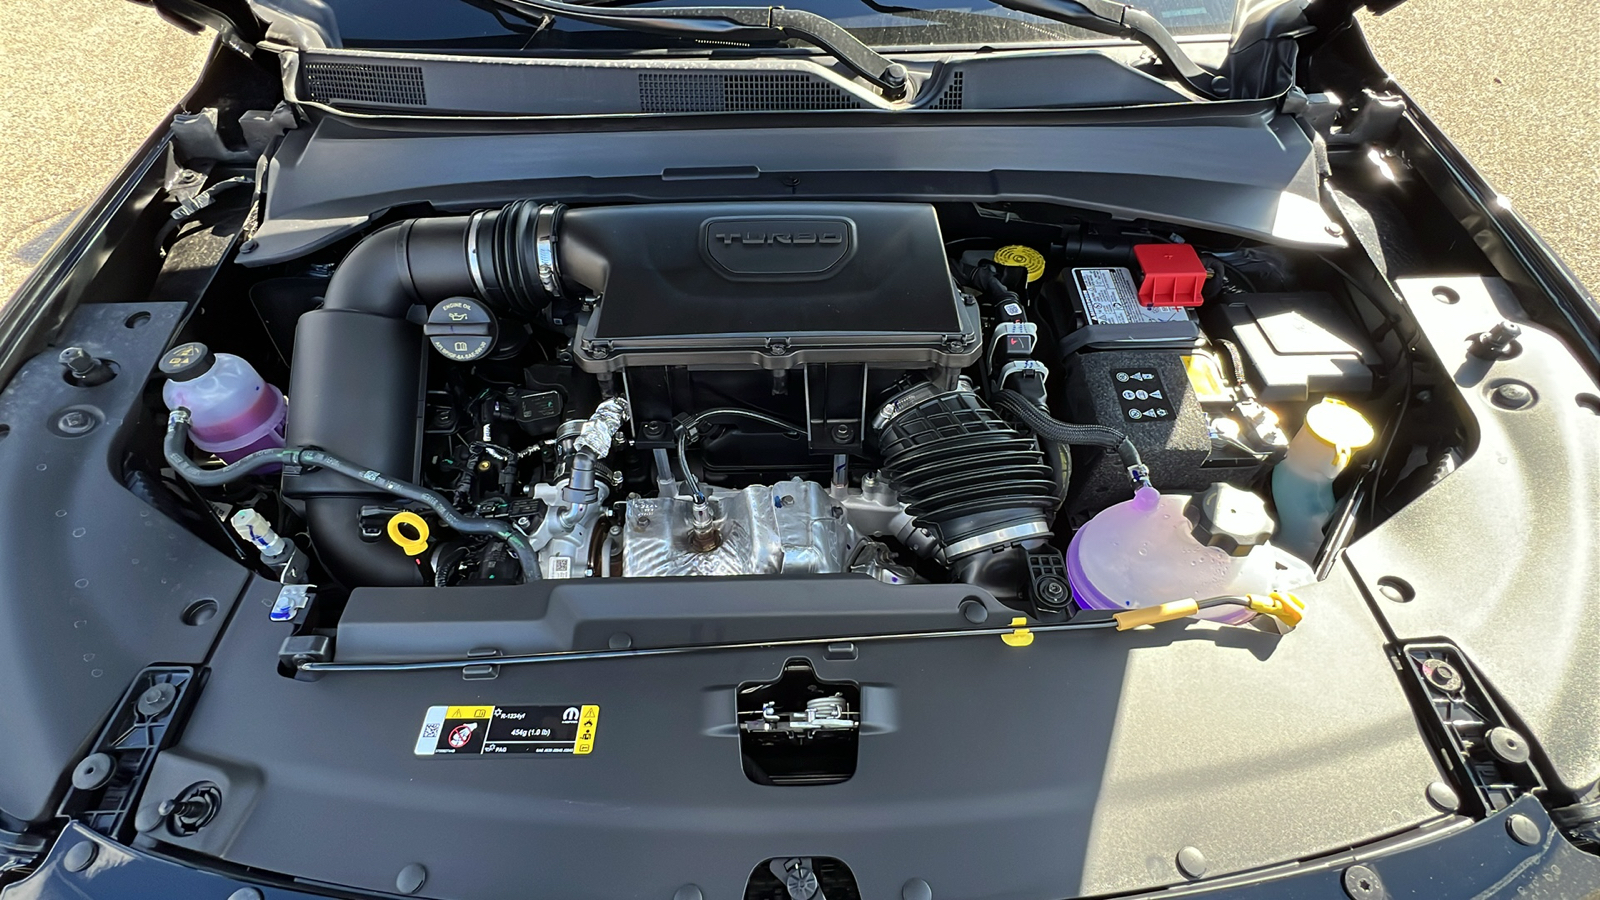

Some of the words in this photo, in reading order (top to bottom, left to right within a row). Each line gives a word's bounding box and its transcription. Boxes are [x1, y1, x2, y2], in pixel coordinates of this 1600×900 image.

[715, 231, 842, 244] TURBO
[442, 302, 462, 311] ENGINE
[462, 303, 472, 311] OIL
[511, 728, 528, 737] 454g
[528, 728, 541, 737] (1.0
[541, 728, 551, 737] lb)
